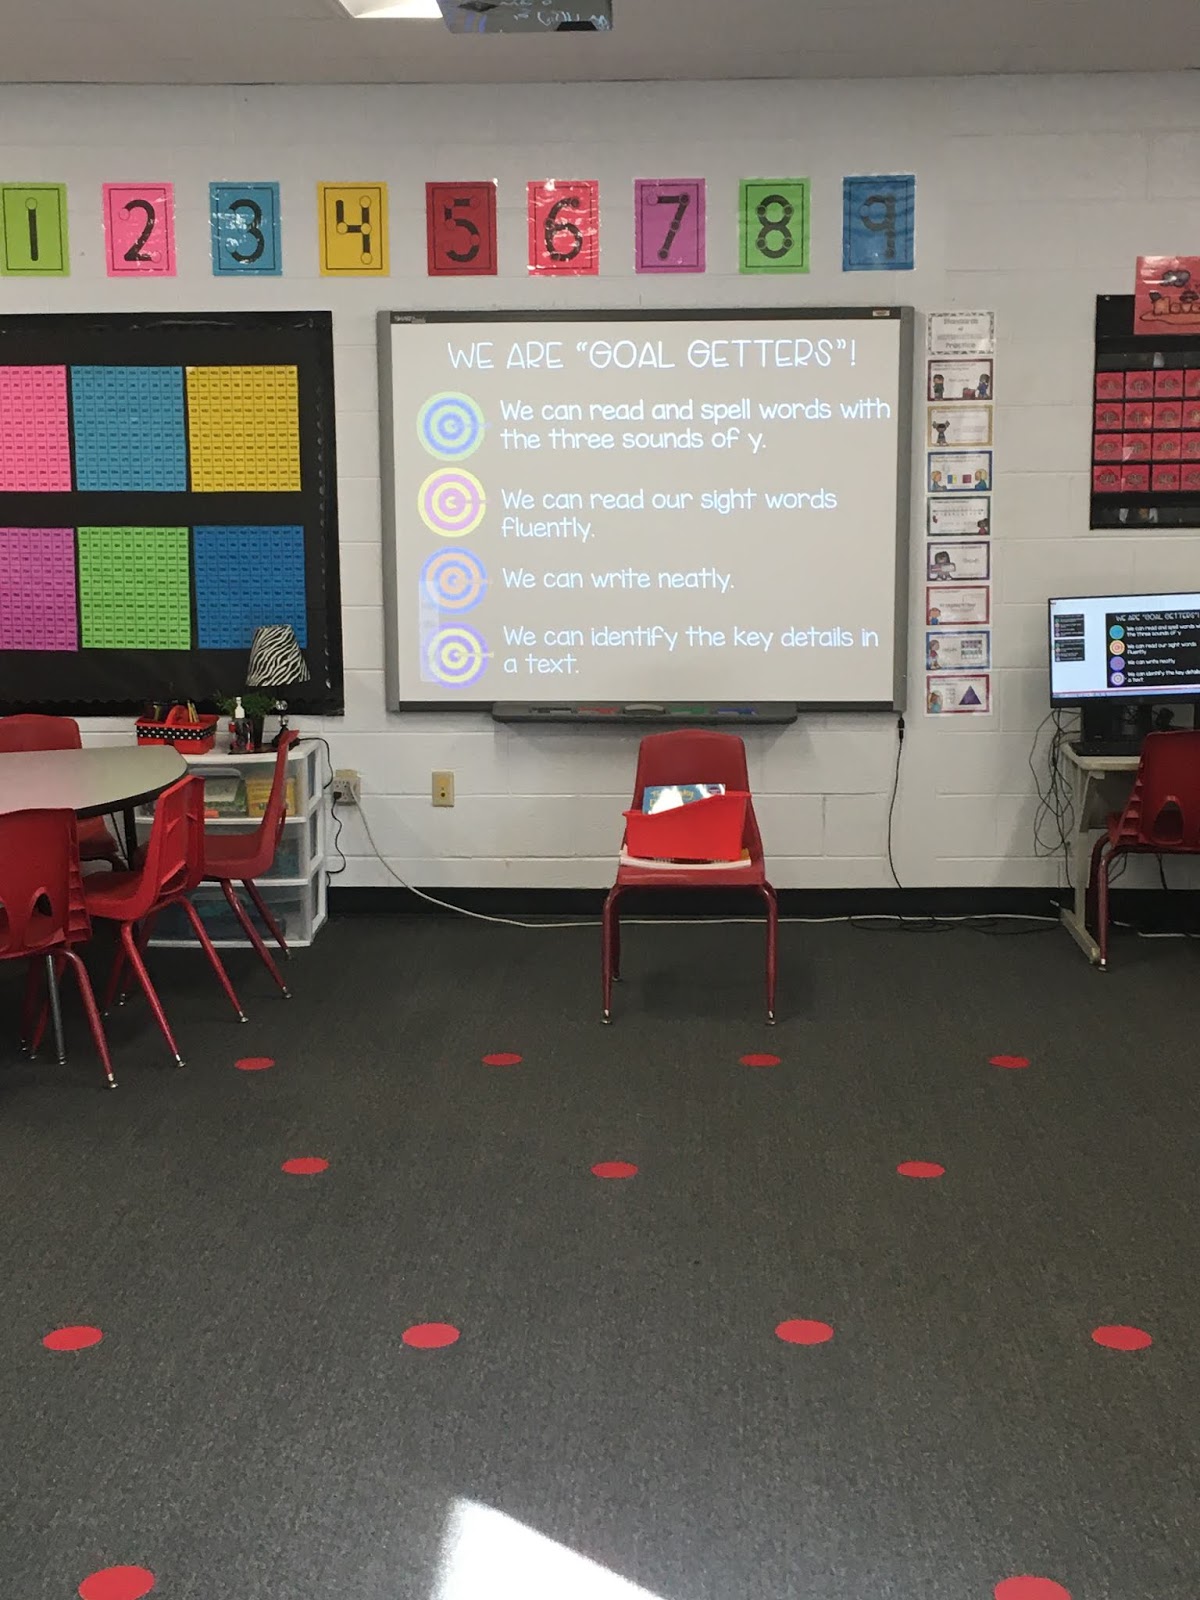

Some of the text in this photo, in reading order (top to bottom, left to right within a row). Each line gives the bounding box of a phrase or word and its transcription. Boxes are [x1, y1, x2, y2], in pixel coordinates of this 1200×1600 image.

[25, 197, 38, 261] 1
[119, 199, 161, 261] 2
[226, 199, 265, 264] 3
[336, 195, 372, 265] 4
[444, 197, 480, 262] 5
[545, 197, 583, 262] 6
[647, 193, 690, 260] 7
[755, 194, 794, 259] 8
[860, 193, 896, 259] 9
[448, 342, 494, 369] WE
[506, 341, 563, 369] ARE
[500, 397, 890, 425] We can read and spell words with
[500, 427, 766, 454] the three sounds of y.
[501, 488, 837, 514] We can read our sight words
[501, 517, 595, 543] fluently.
[503, 568, 734, 593] We can write neatly.
[504, 626, 879, 651] We can identify the key details in
[504, 654, 579, 674] a text.
